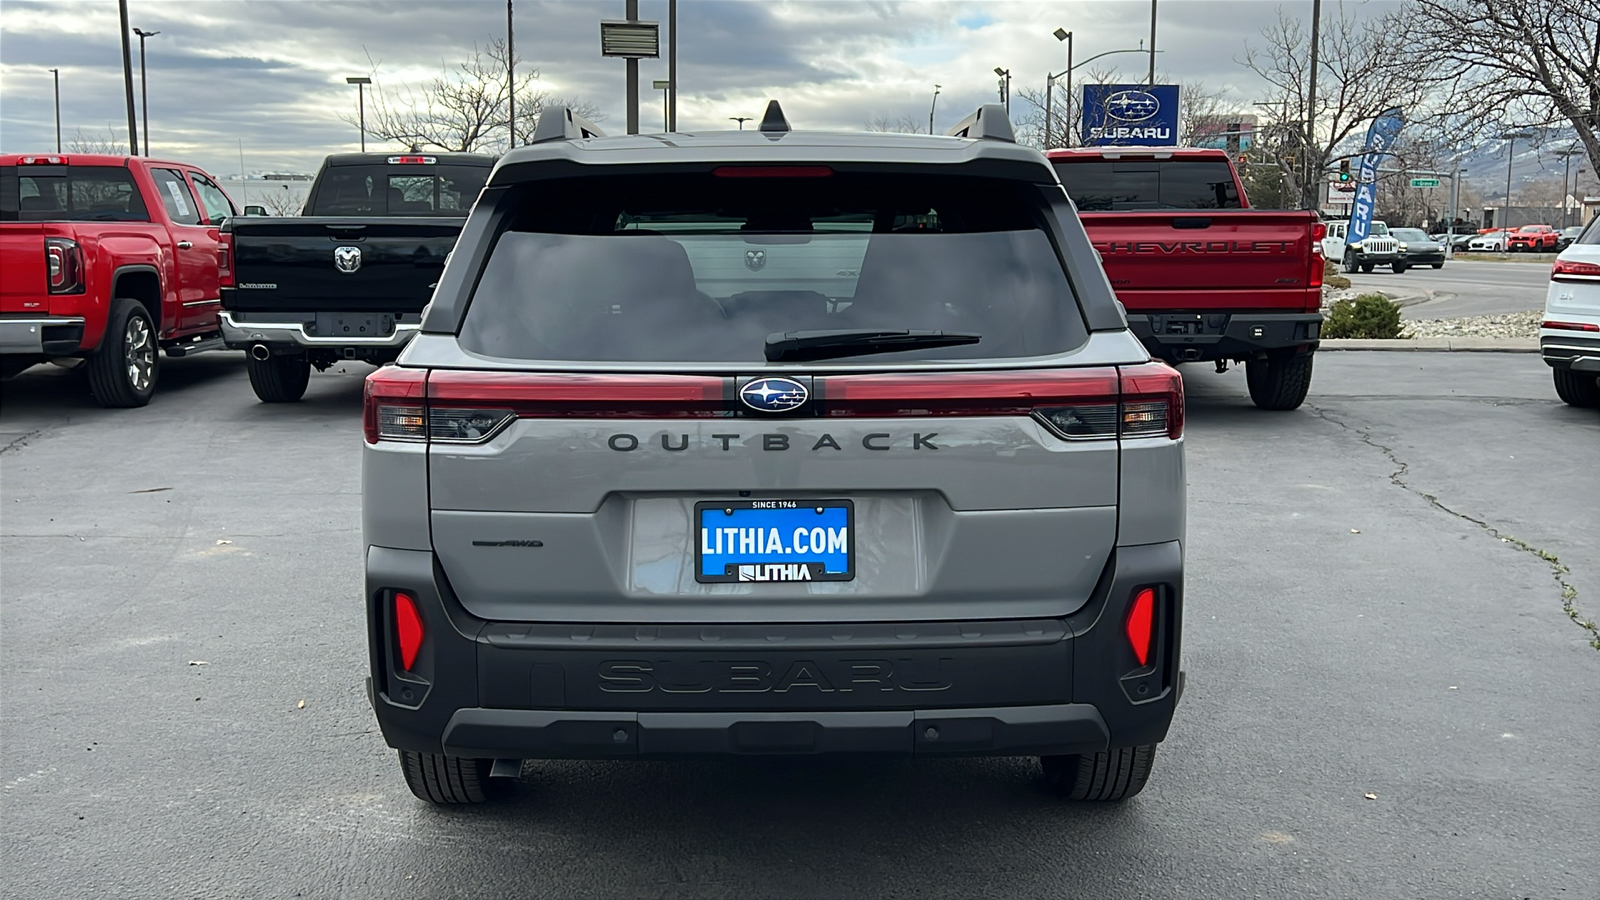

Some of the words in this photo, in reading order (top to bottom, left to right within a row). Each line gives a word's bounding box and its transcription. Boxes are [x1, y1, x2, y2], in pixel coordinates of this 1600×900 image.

[1090, 127, 1170, 139] SUBARU
[1092, 241, 1294, 254] CHEVROLET
[607, 432, 940, 451] OUTBACK
[752, 501, 777, 509] SINCE
[701, 527, 848, 555] LITHIA.COM
[755, 564, 812, 581] LITHIA
[599, 659, 953, 693] SUBARU
